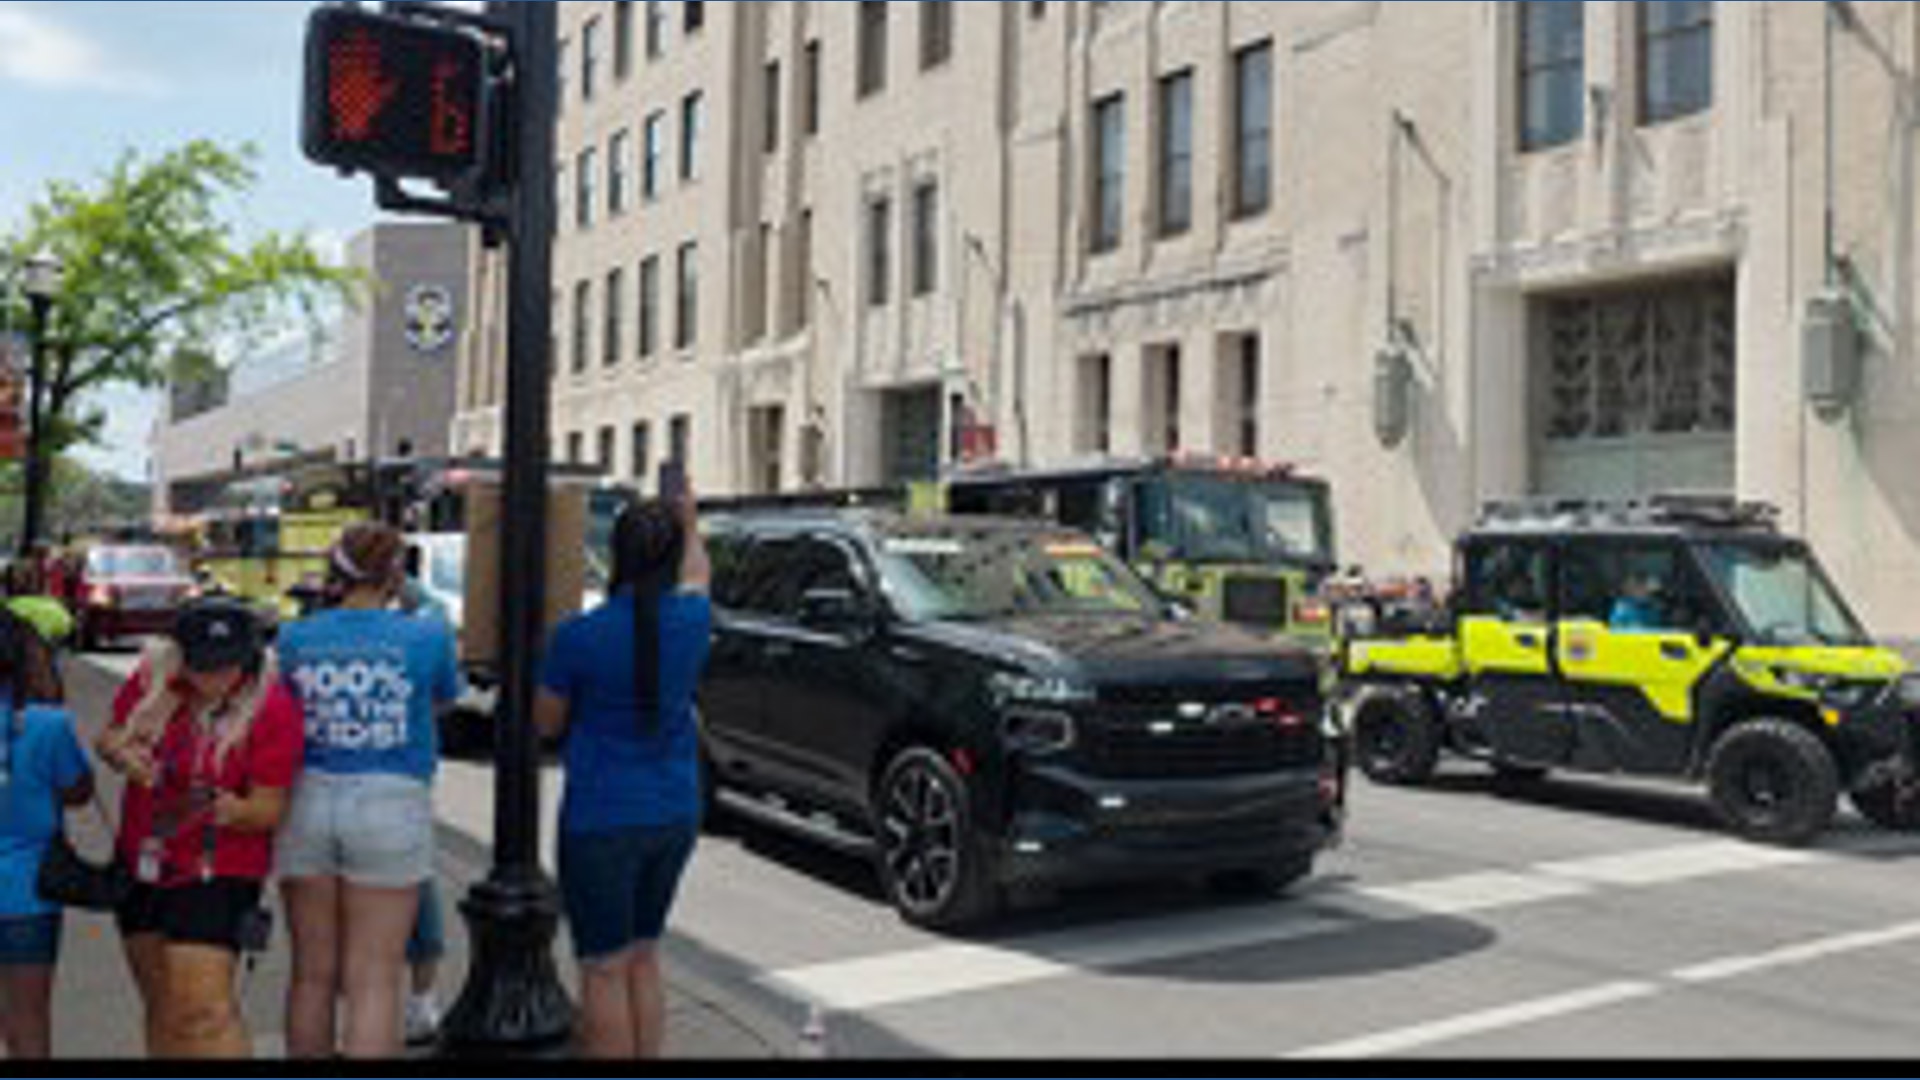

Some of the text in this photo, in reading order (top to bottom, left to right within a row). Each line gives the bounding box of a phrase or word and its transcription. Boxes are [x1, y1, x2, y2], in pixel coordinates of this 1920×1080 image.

[430, 55, 470, 154] 6
[294, 661, 413, 699] 100%
[353, 699, 406, 722] THE
